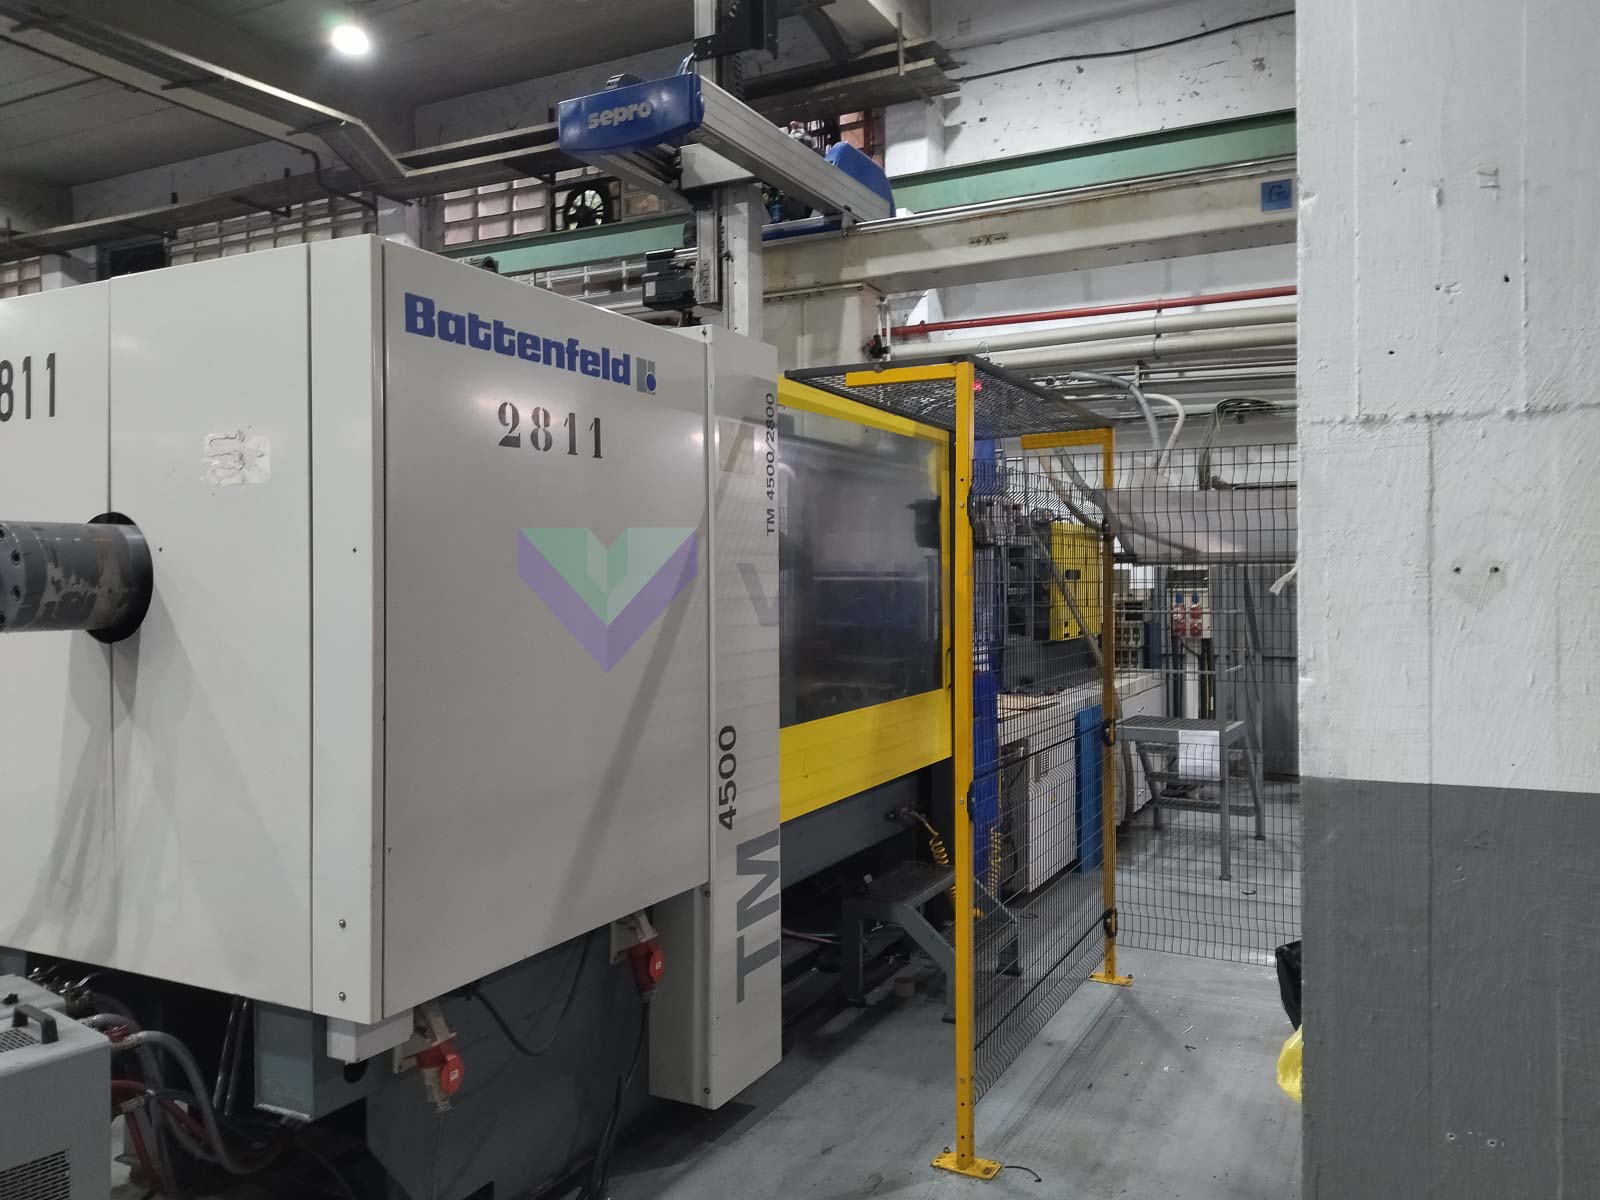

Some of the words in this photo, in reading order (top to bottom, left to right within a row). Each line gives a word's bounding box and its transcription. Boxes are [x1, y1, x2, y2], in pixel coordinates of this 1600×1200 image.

[587, 100, 653, 130] sepro
[404, 292, 631, 386] Battenfeld
[0, 353, 55, 422] 811
[498, 402, 604, 459] 2811
[765, 393, 776, 501] 4500/2800
[766, 508, 776, 537] TM
[718, 726, 738, 831] 4500
[736, 829, 781, 1004] TM
